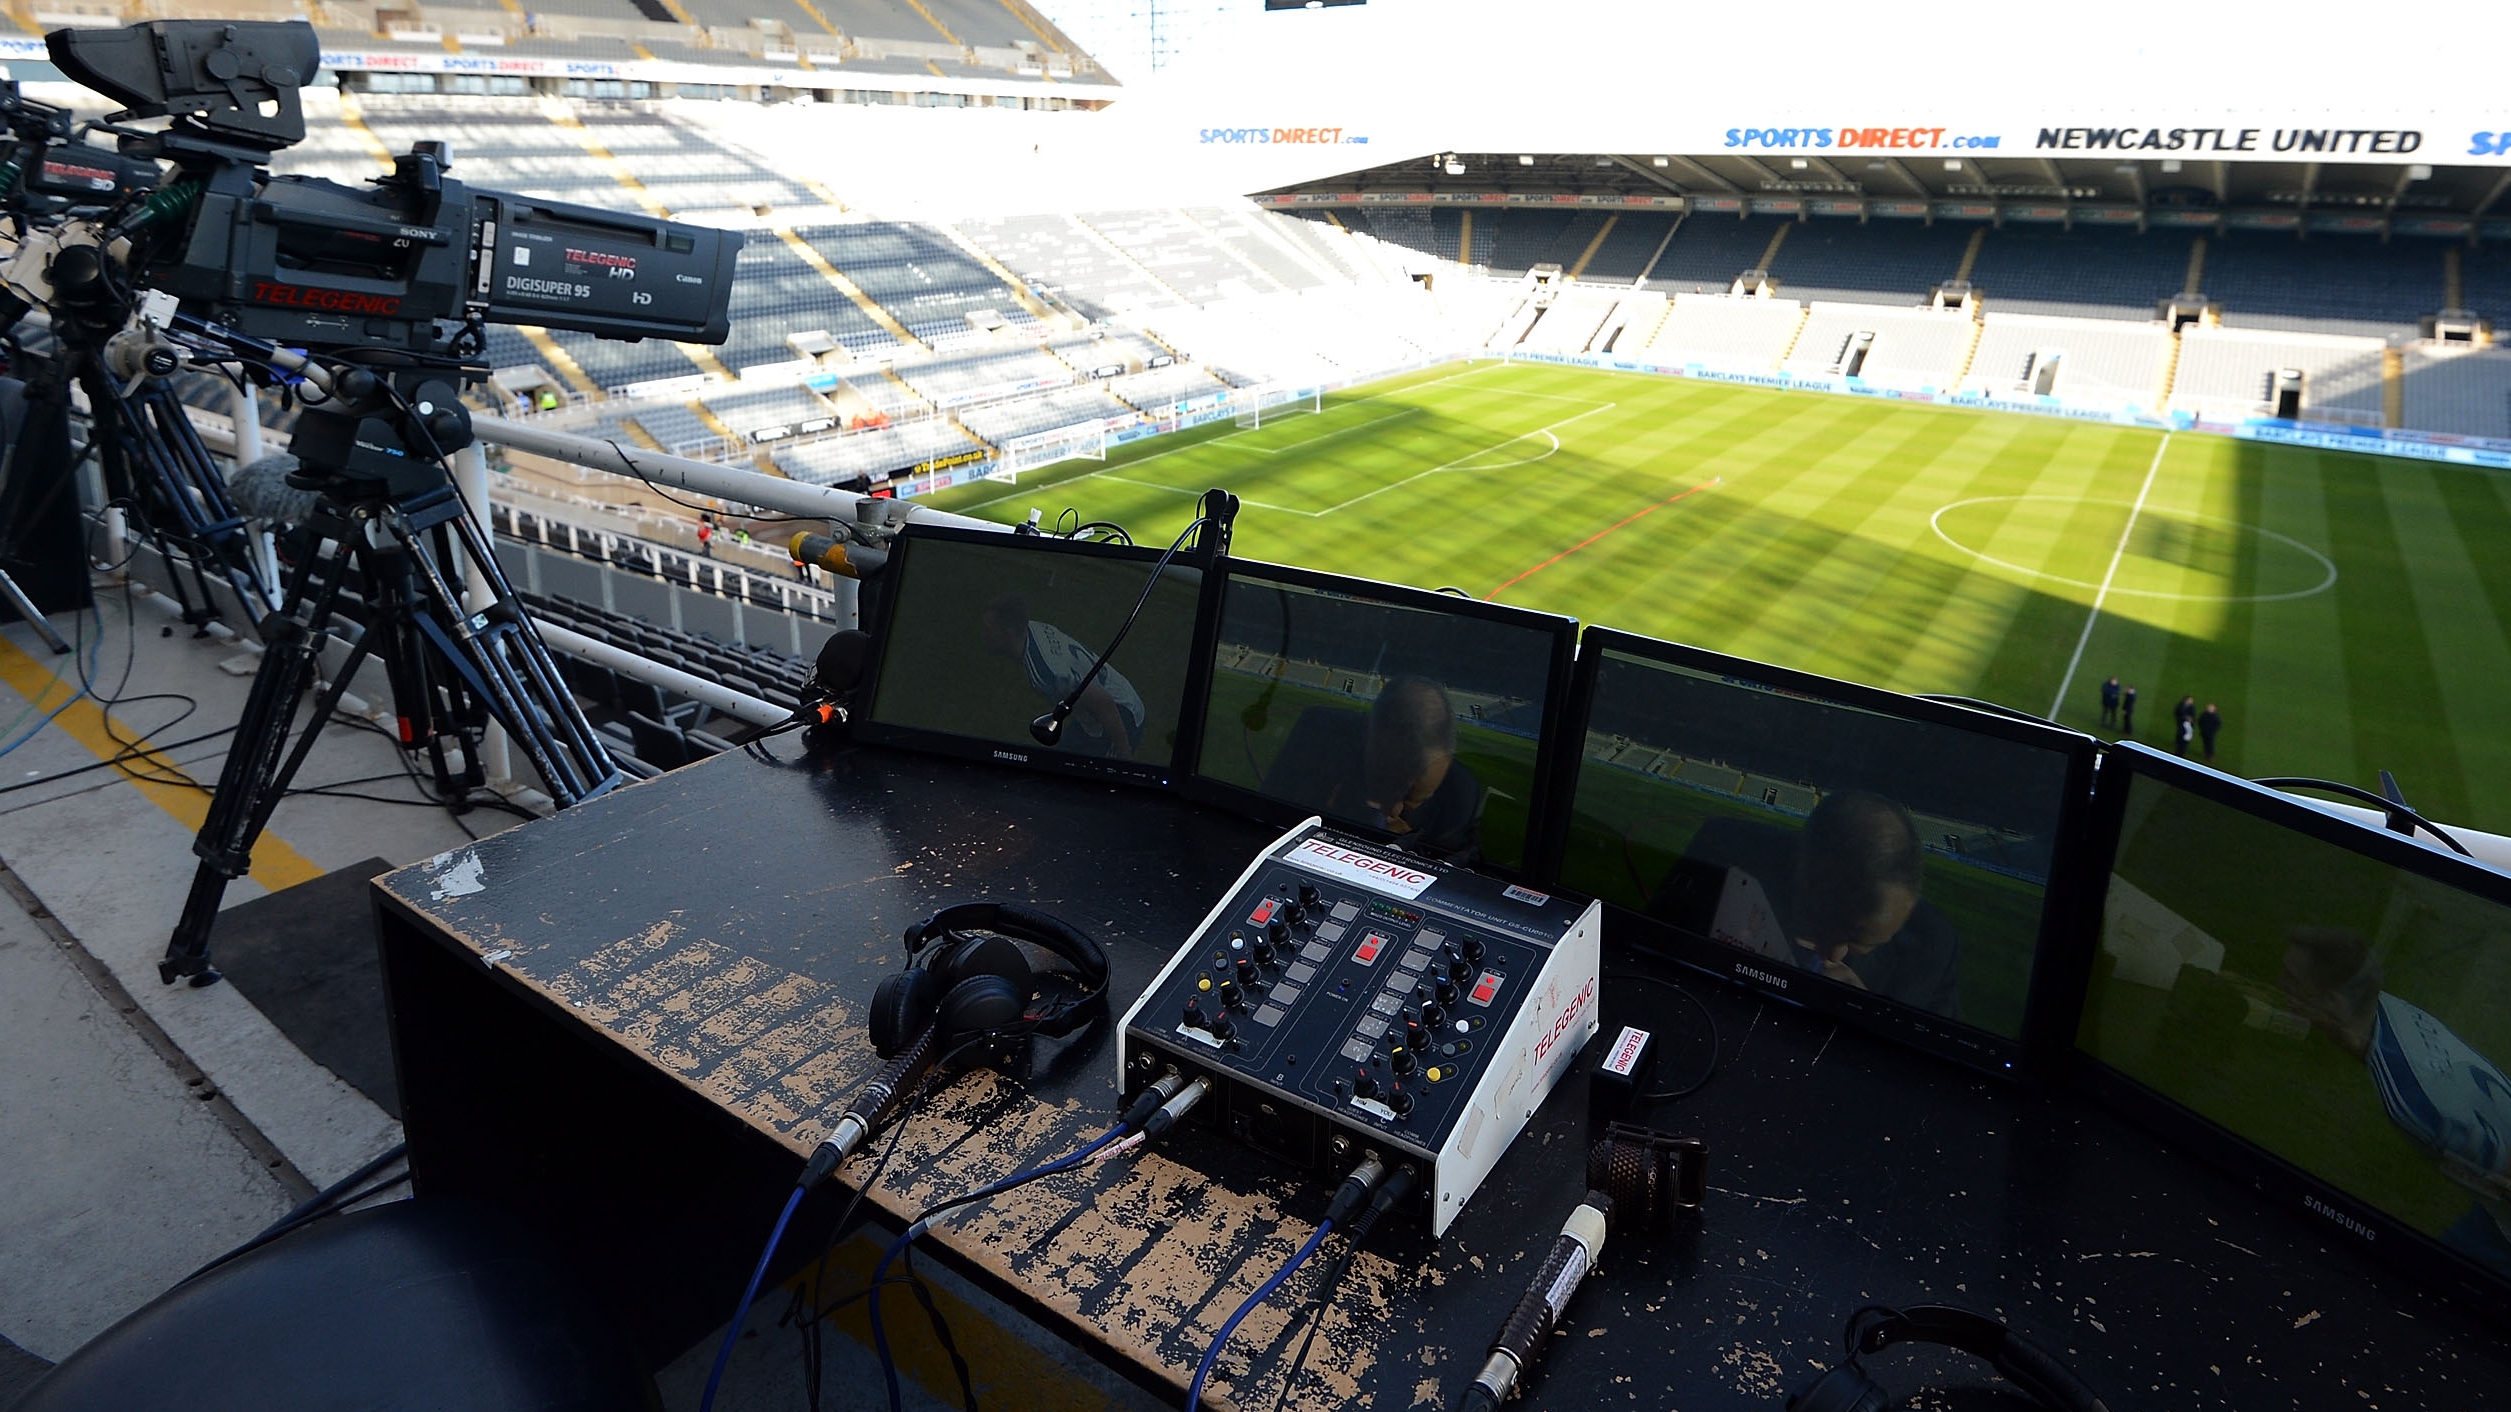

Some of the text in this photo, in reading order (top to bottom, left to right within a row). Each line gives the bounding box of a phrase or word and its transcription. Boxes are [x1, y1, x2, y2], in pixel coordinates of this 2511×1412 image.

[442, 57, 497, 70] SPORTS
[1200, 128, 1270, 144] SPORTS
[1724, 128, 1833, 148] SPORTS
[2036, 128, 2423, 153] NEWCASTLE UNITED
[400, 228, 438, 240] SONY
[565, 247, 637, 269] TELEGENIC
[609, 266, 635, 281] HD
[676, 273, 703, 284] Canon
[507, 275, 572, 296] DIGISUPER
[574, 284, 591, 298] 95
[254, 281, 401, 315] TELEGENIC
[632, 291, 652, 305] HD
[1567, 356, 1599, 367] LEAGUE
[1697, 370, 1746, 383] BARCLAYS
[1749, 374, 1790, 388] PREMIER
[1794, 379, 1832, 391] LEAGUE
[1951, 396, 2112, 421] BARCLAYS PREMIER LEAGUE
[993, 750, 1028, 762] SAMSUNG
[1302, 840, 1426, 885] TELEGENIC
[1338, 837, 1383, 855] GLENSOUND
[1383, 849, 1433, 868] ELECTRONICS
[1433, 865, 1449, 873] LTD
[1426, 895, 1487, 918] COMMENTATOR
[1488, 914, 1507, 925] UNIT
[1735, 963, 1788, 989] SAMSUNG
[1533, 976, 1594, 1066] TELEGENIC
[1615, 1031, 1644, 1072] TELEGENIC
[1276, 1073, 1284, 1081] B
[1380, 1108, 1393, 1117] YOU
[2304, 1194, 2377, 1242] SAMSUNG
